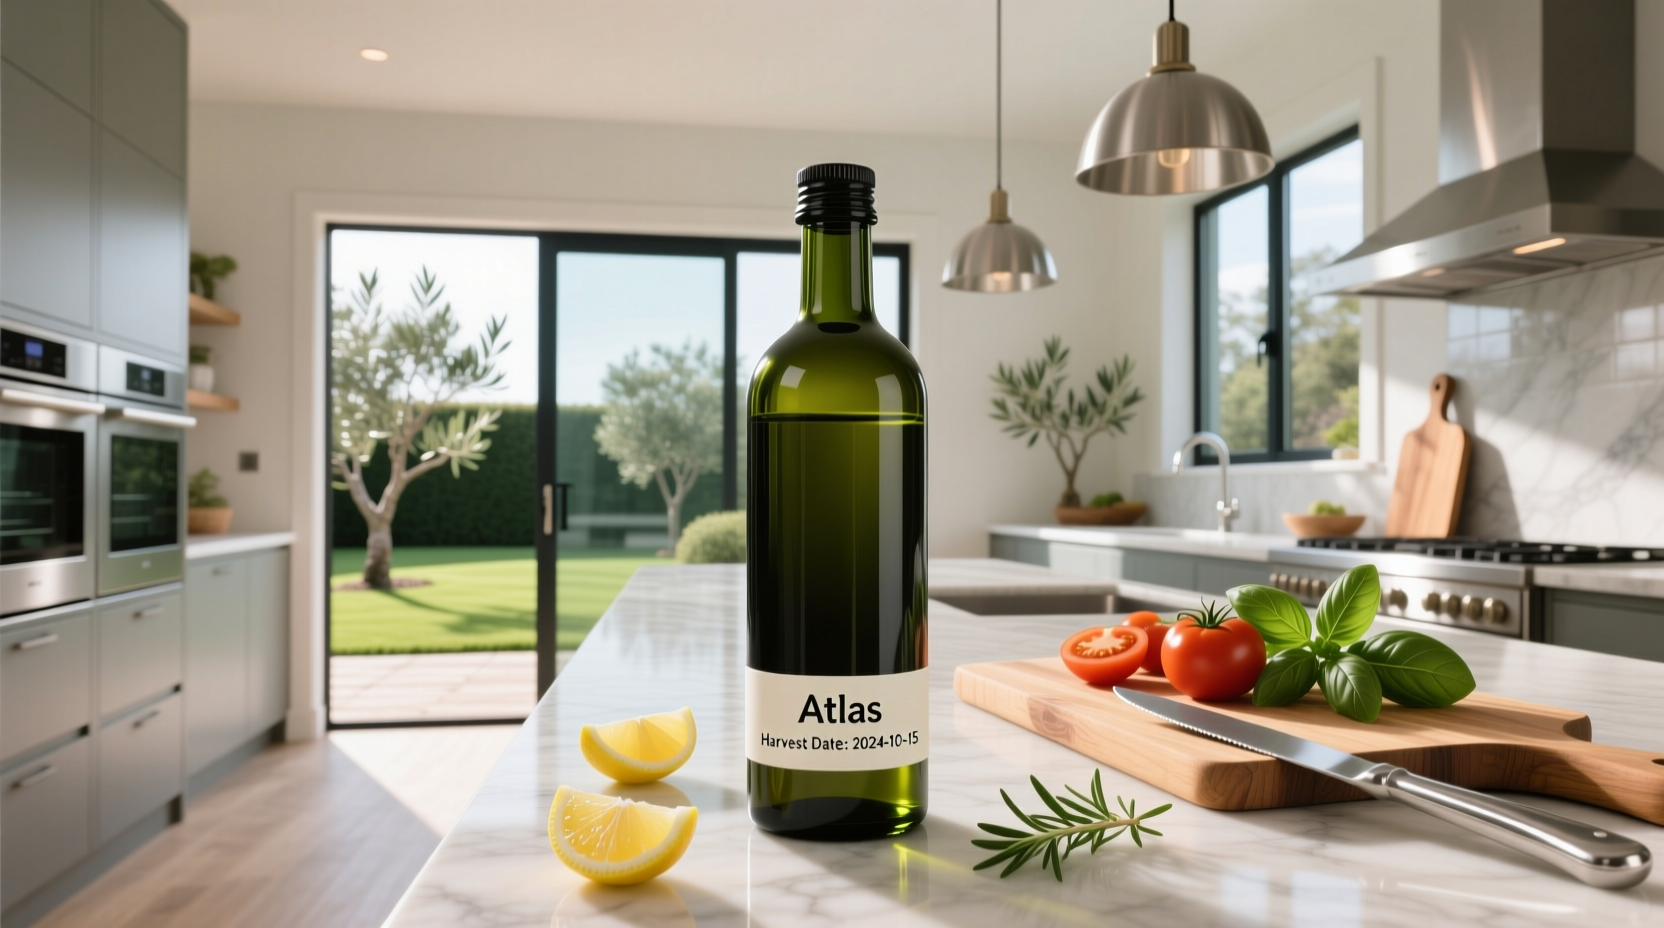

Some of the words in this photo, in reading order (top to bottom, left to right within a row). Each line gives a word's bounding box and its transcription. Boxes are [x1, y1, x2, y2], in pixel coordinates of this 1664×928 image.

[798, 694, 882, 724] Atlas
[761, 732, 808, 750] Harvest
[811, 736, 848, 751] Date:
[852, 730, 919, 750] 2024-10-15
